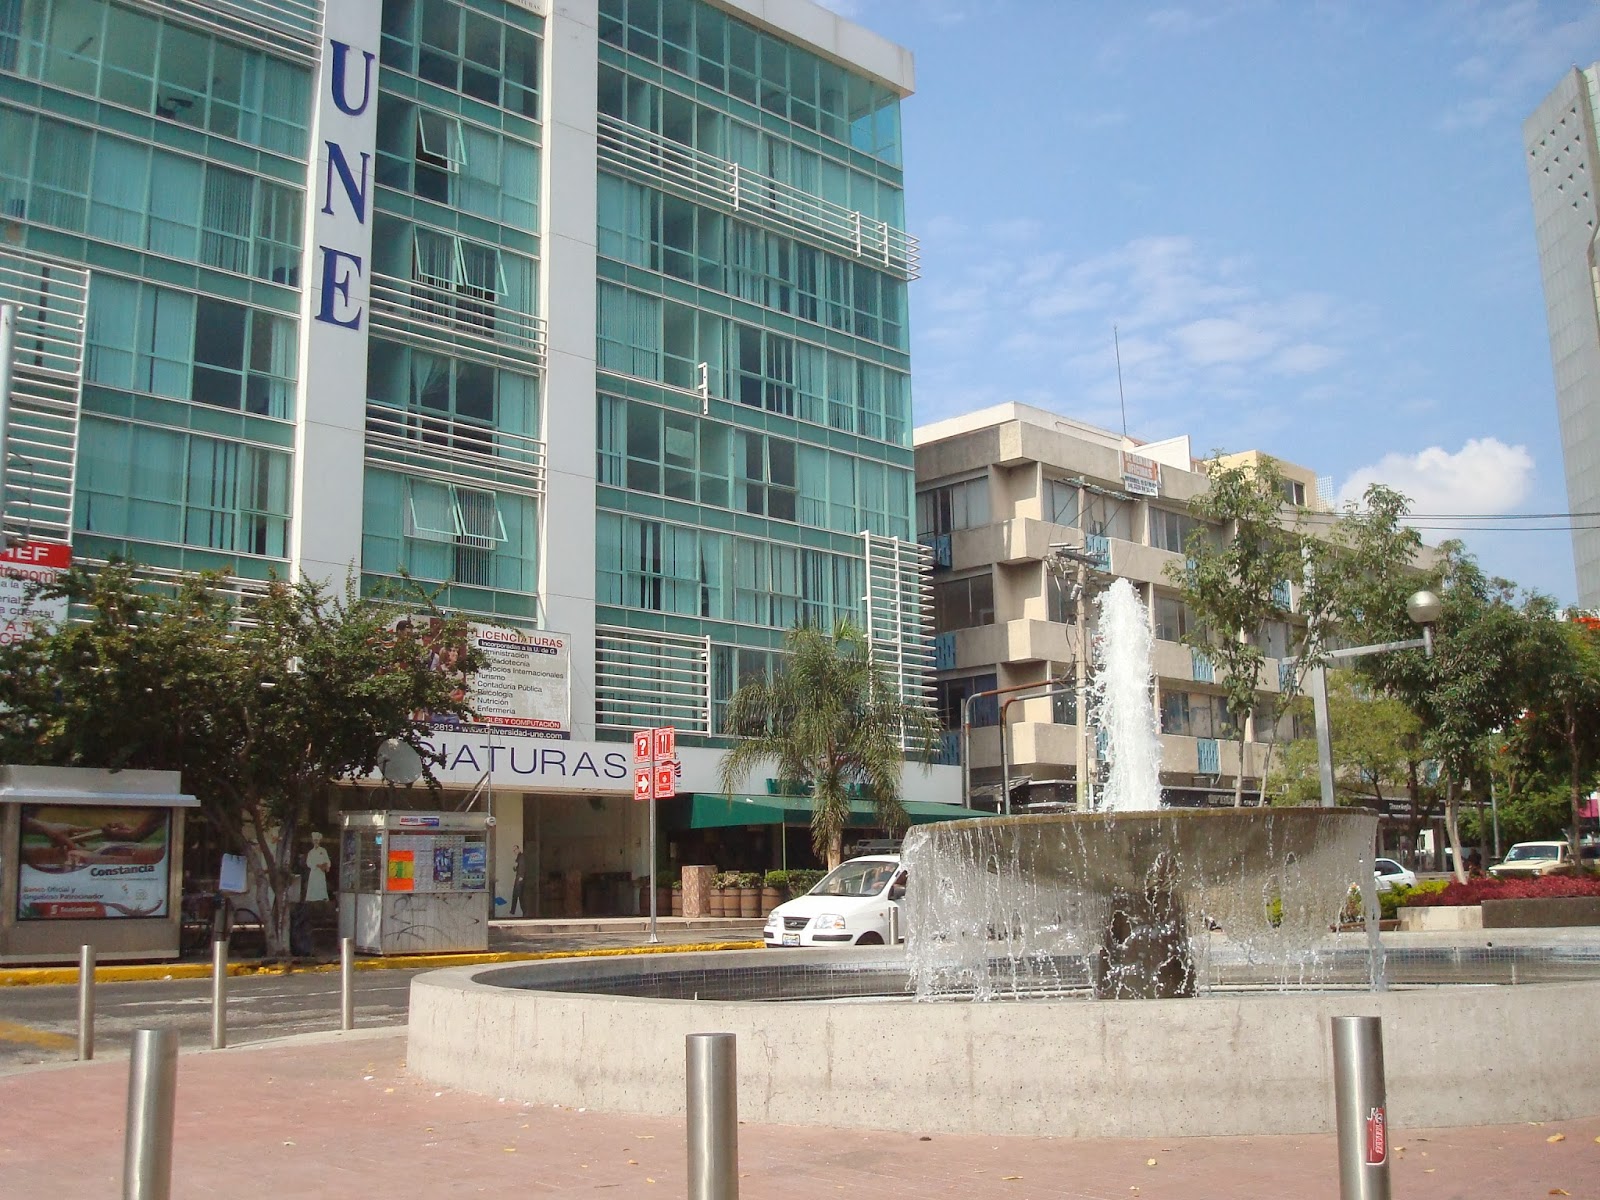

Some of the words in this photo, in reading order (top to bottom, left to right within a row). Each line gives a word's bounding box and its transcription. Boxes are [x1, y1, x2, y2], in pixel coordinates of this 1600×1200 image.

[315, 39, 376, 331] UNE
[475, 630, 563, 648] LICENCIATURAS
[481, 641, 520, 651] Incorporadas
[478, 673, 506, 681] Turismo
[512, 667, 564, 679] Internacionales
[517, 684, 543, 693] Pública
[477, 697, 509, 706] Nutrición
[510, 718, 560, 728] COMPUTACIÓN
[90, 864, 155, 877] Constancia
